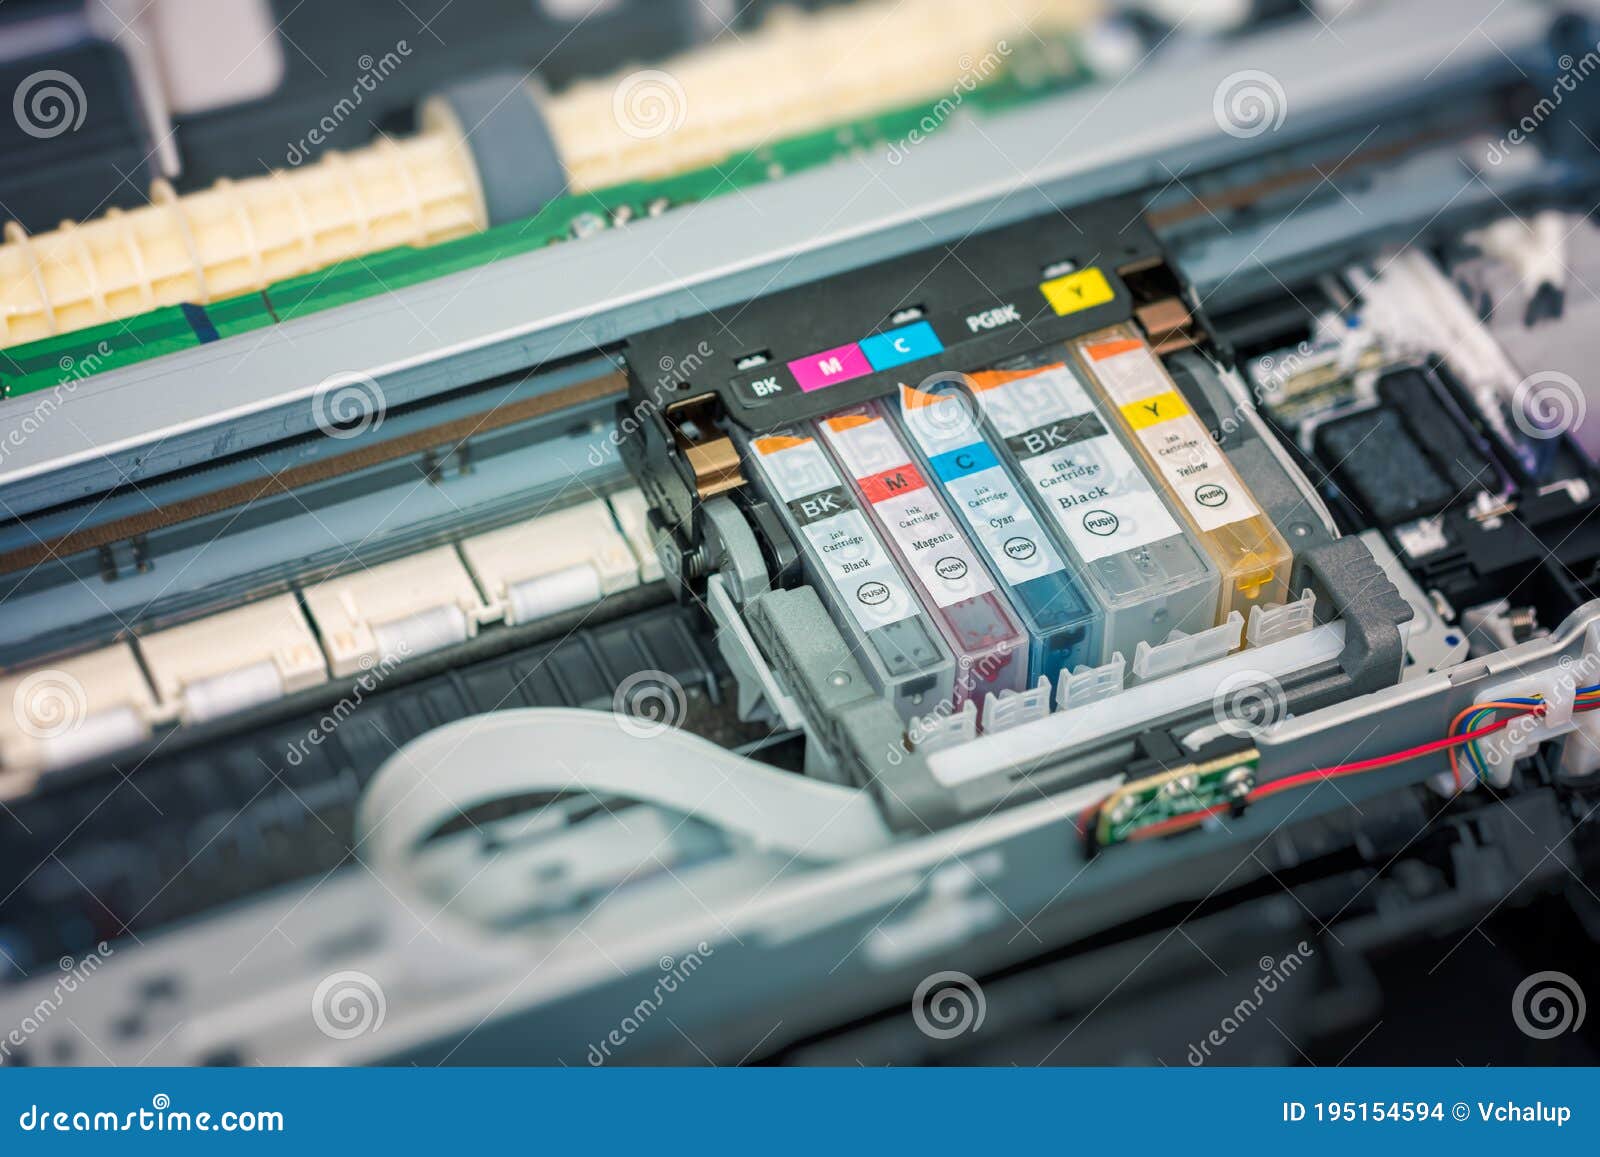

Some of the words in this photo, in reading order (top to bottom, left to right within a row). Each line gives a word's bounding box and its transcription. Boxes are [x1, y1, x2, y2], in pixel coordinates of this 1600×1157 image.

[752, 376, 782, 397] BK
[818, 357, 843, 376] M
[894, 338, 911, 353] C
[966, 304, 1022, 333] PGBK
[1069, 286, 1083, 298] Y
[1144, 402, 1160, 417] Y
[1023, 425, 1068, 454] BK
[1158, 439, 1199, 457] Cartridge
[956, 454, 974, 470] C
[1052, 458, 1076, 473] Ink
[1176, 461, 1209, 478] Yellow
[884, 473, 908, 491] M
[1039, 463, 1100, 489] Cartridge
[974, 486, 990, 496] Ink
[1057, 485, 1110, 510] Black
[1199, 489, 1224, 502] PUSH
[800, 494, 840, 518] BK
[967, 490, 1009, 509] Cartridge
[905, 506, 922, 516] Ink
[899, 510, 941, 529] Cartridge
[989, 514, 1015, 529] Cyan
[1087, 516, 1115, 529] PUSH
[829, 530, 845, 540] Ink
[912, 533, 954, 551] Magenta
[822, 535, 864, 553] Cartridge
[1007, 543, 1032, 555] PUSH
[842, 558, 871, 574] Black
[940, 562, 964, 575] PUSH
[861, 587, 887, 600] PUSH
